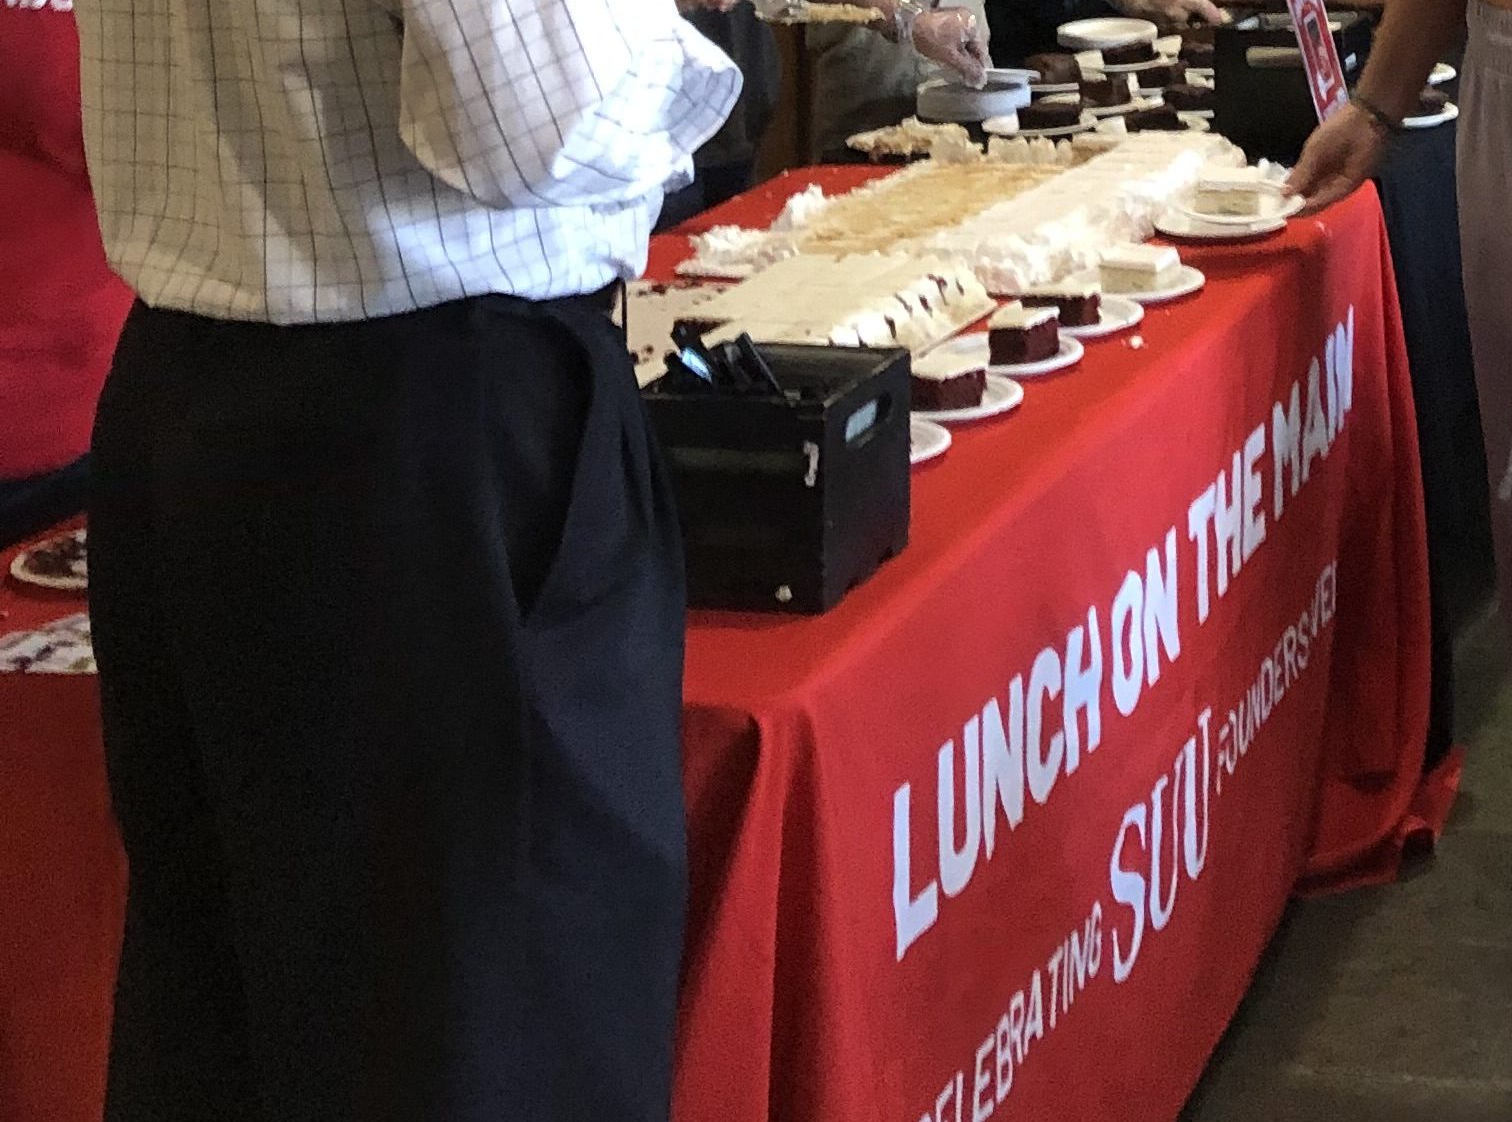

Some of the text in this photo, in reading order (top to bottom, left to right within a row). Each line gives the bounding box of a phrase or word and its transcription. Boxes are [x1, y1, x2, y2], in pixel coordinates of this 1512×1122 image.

[893, 304, 1354, 963] LUNCH ON THE MAIN
[917, 900, 1102, 1122] LEBRATING
[1110, 705, 1212, 984] SUU
